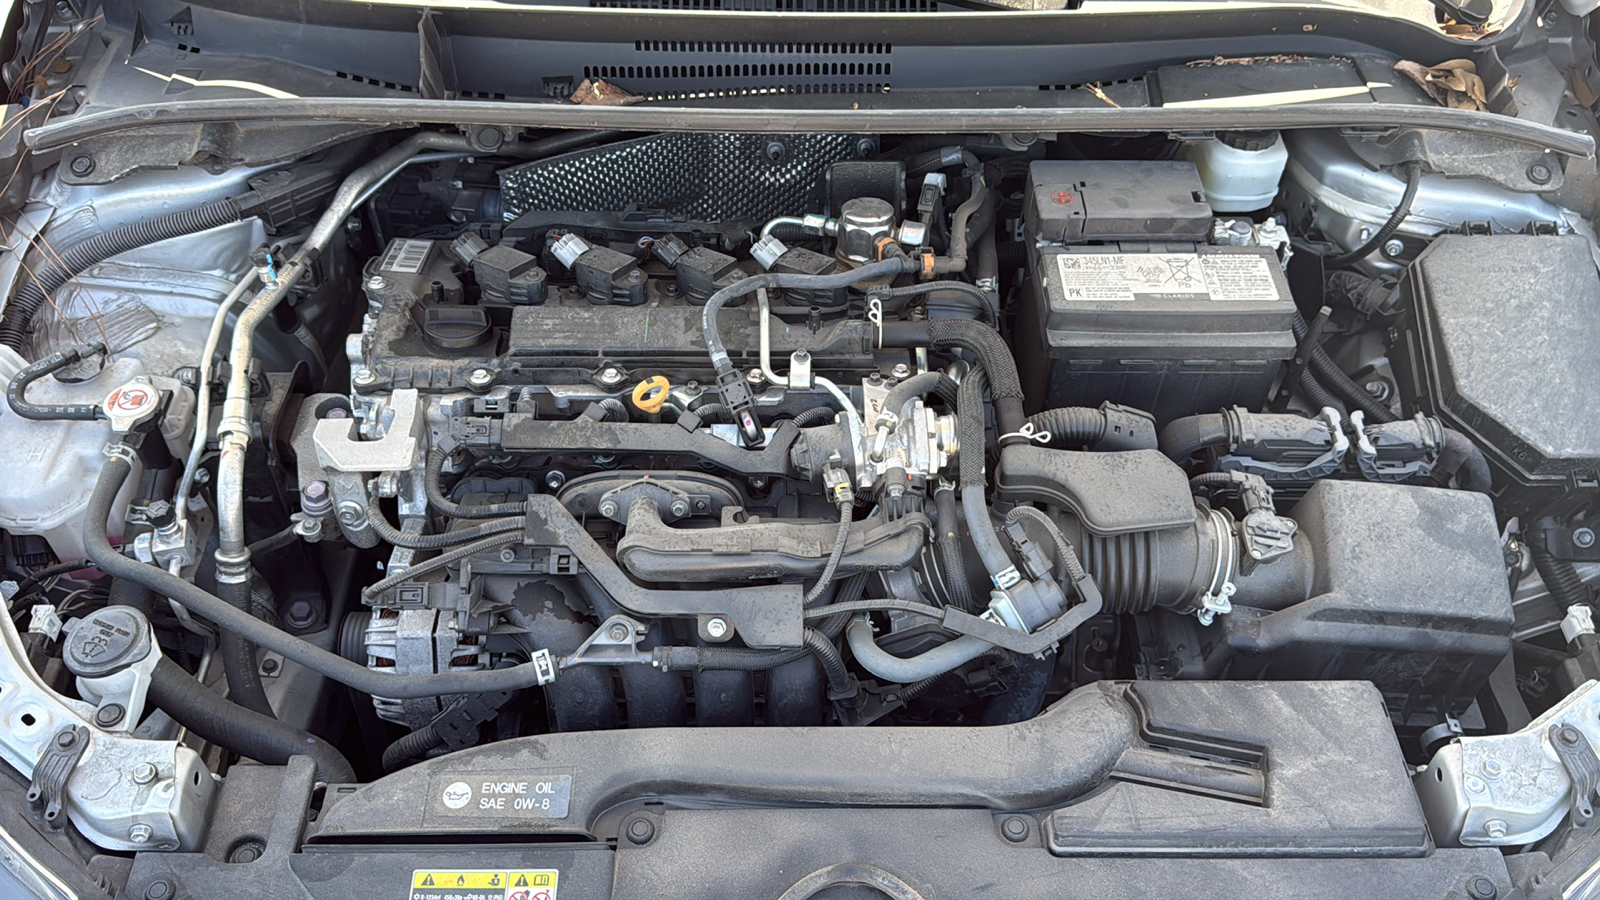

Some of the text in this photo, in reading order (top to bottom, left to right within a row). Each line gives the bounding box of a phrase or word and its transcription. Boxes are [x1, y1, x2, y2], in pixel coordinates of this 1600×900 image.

[1068, 288, 1083, 298] PK
[481, 782, 556, 794] ENGINE OIL
[479, 798, 550, 810] SAE 0W-8
